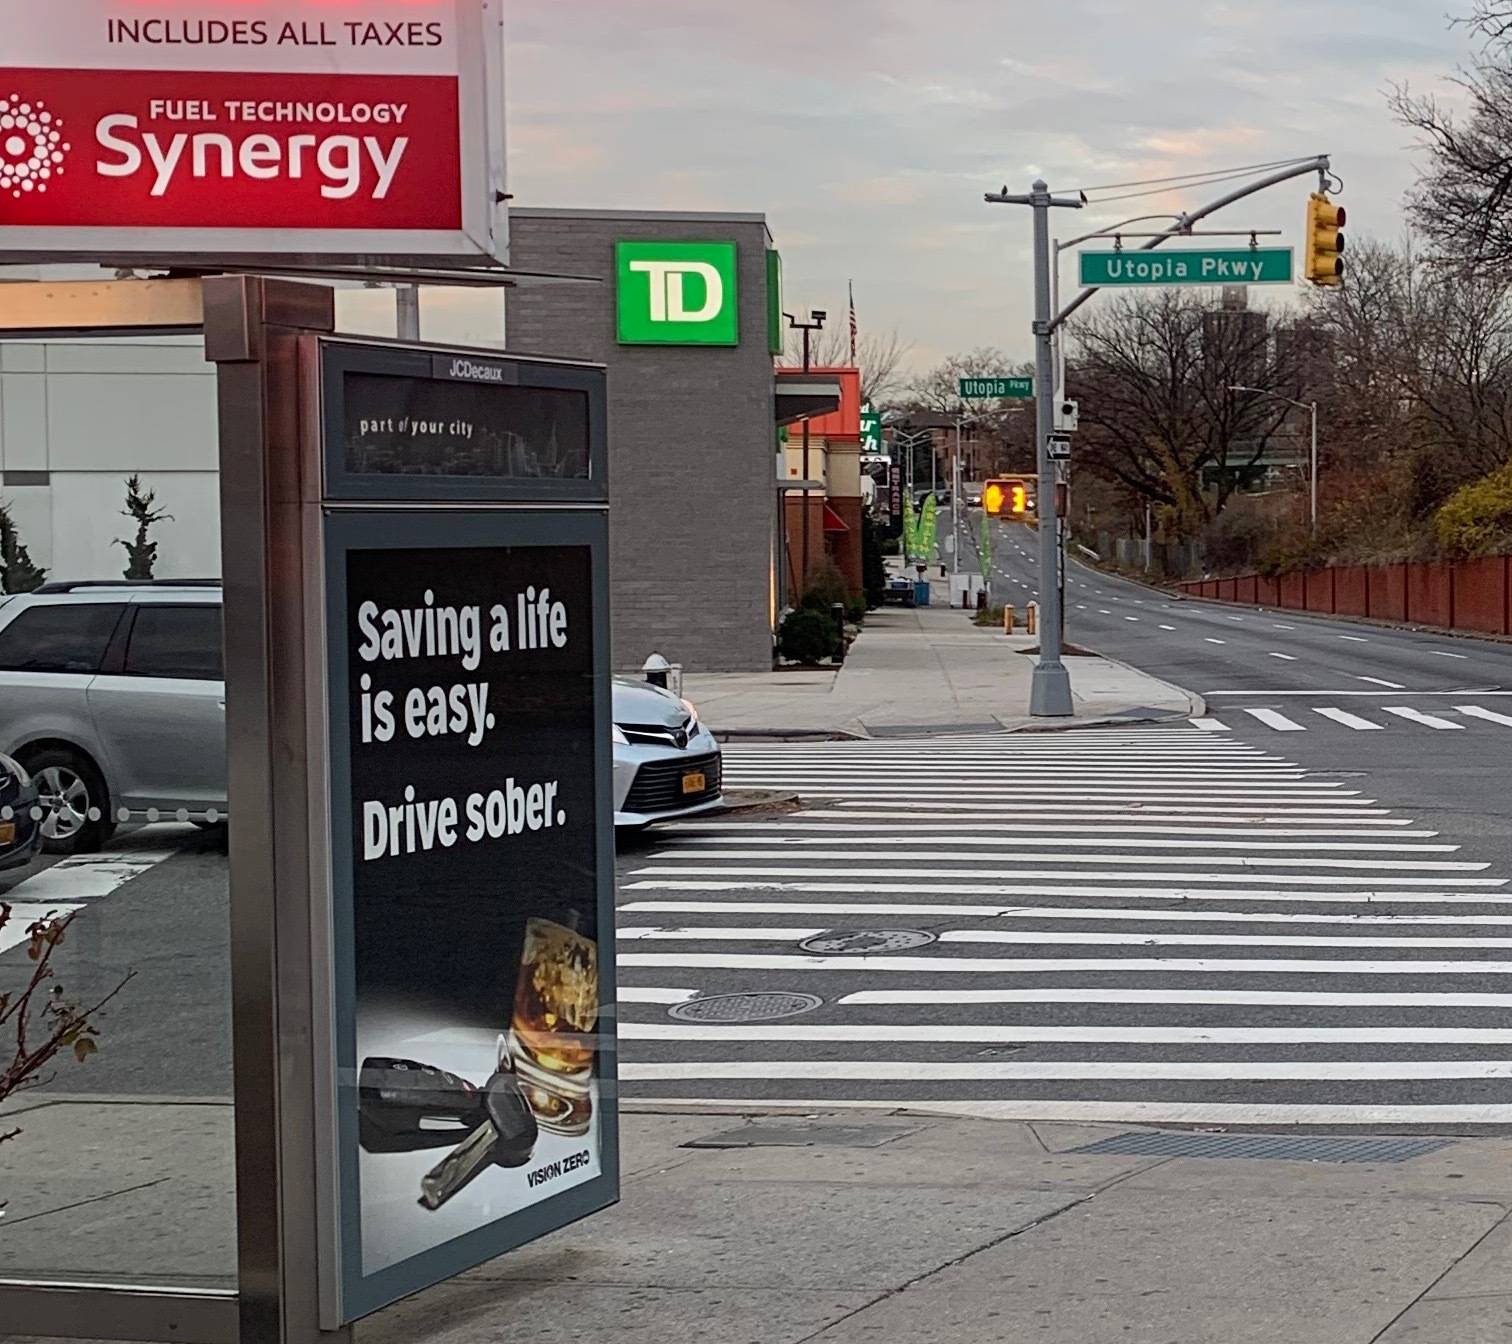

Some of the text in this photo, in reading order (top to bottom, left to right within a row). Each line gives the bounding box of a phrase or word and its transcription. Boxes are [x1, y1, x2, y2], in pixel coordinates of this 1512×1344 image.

[107, 19, 442, 46] INCLUDES ALL TAXES
[150, 100, 408, 124] FUEL TECHNOLOGY
[95, 113, 409, 199] Synergy
[1106, 257, 1264, 281] Utopia Pkwy
[629, 260, 723, 322] TD
[449, 359, 503, 381] JCDecaux
[964, 379, 1031, 398] Utopia Pkwy
[359, 417, 394, 437] part
[411, 420, 445, 437] your
[449, 419, 474, 440] city
[357, 585, 568, 671] Saving a life
[359, 672, 496, 747] is easy.
[363, 776, 567, 861] Drive sober.
[527, 1149, 590, 1189] VISION ZERO
